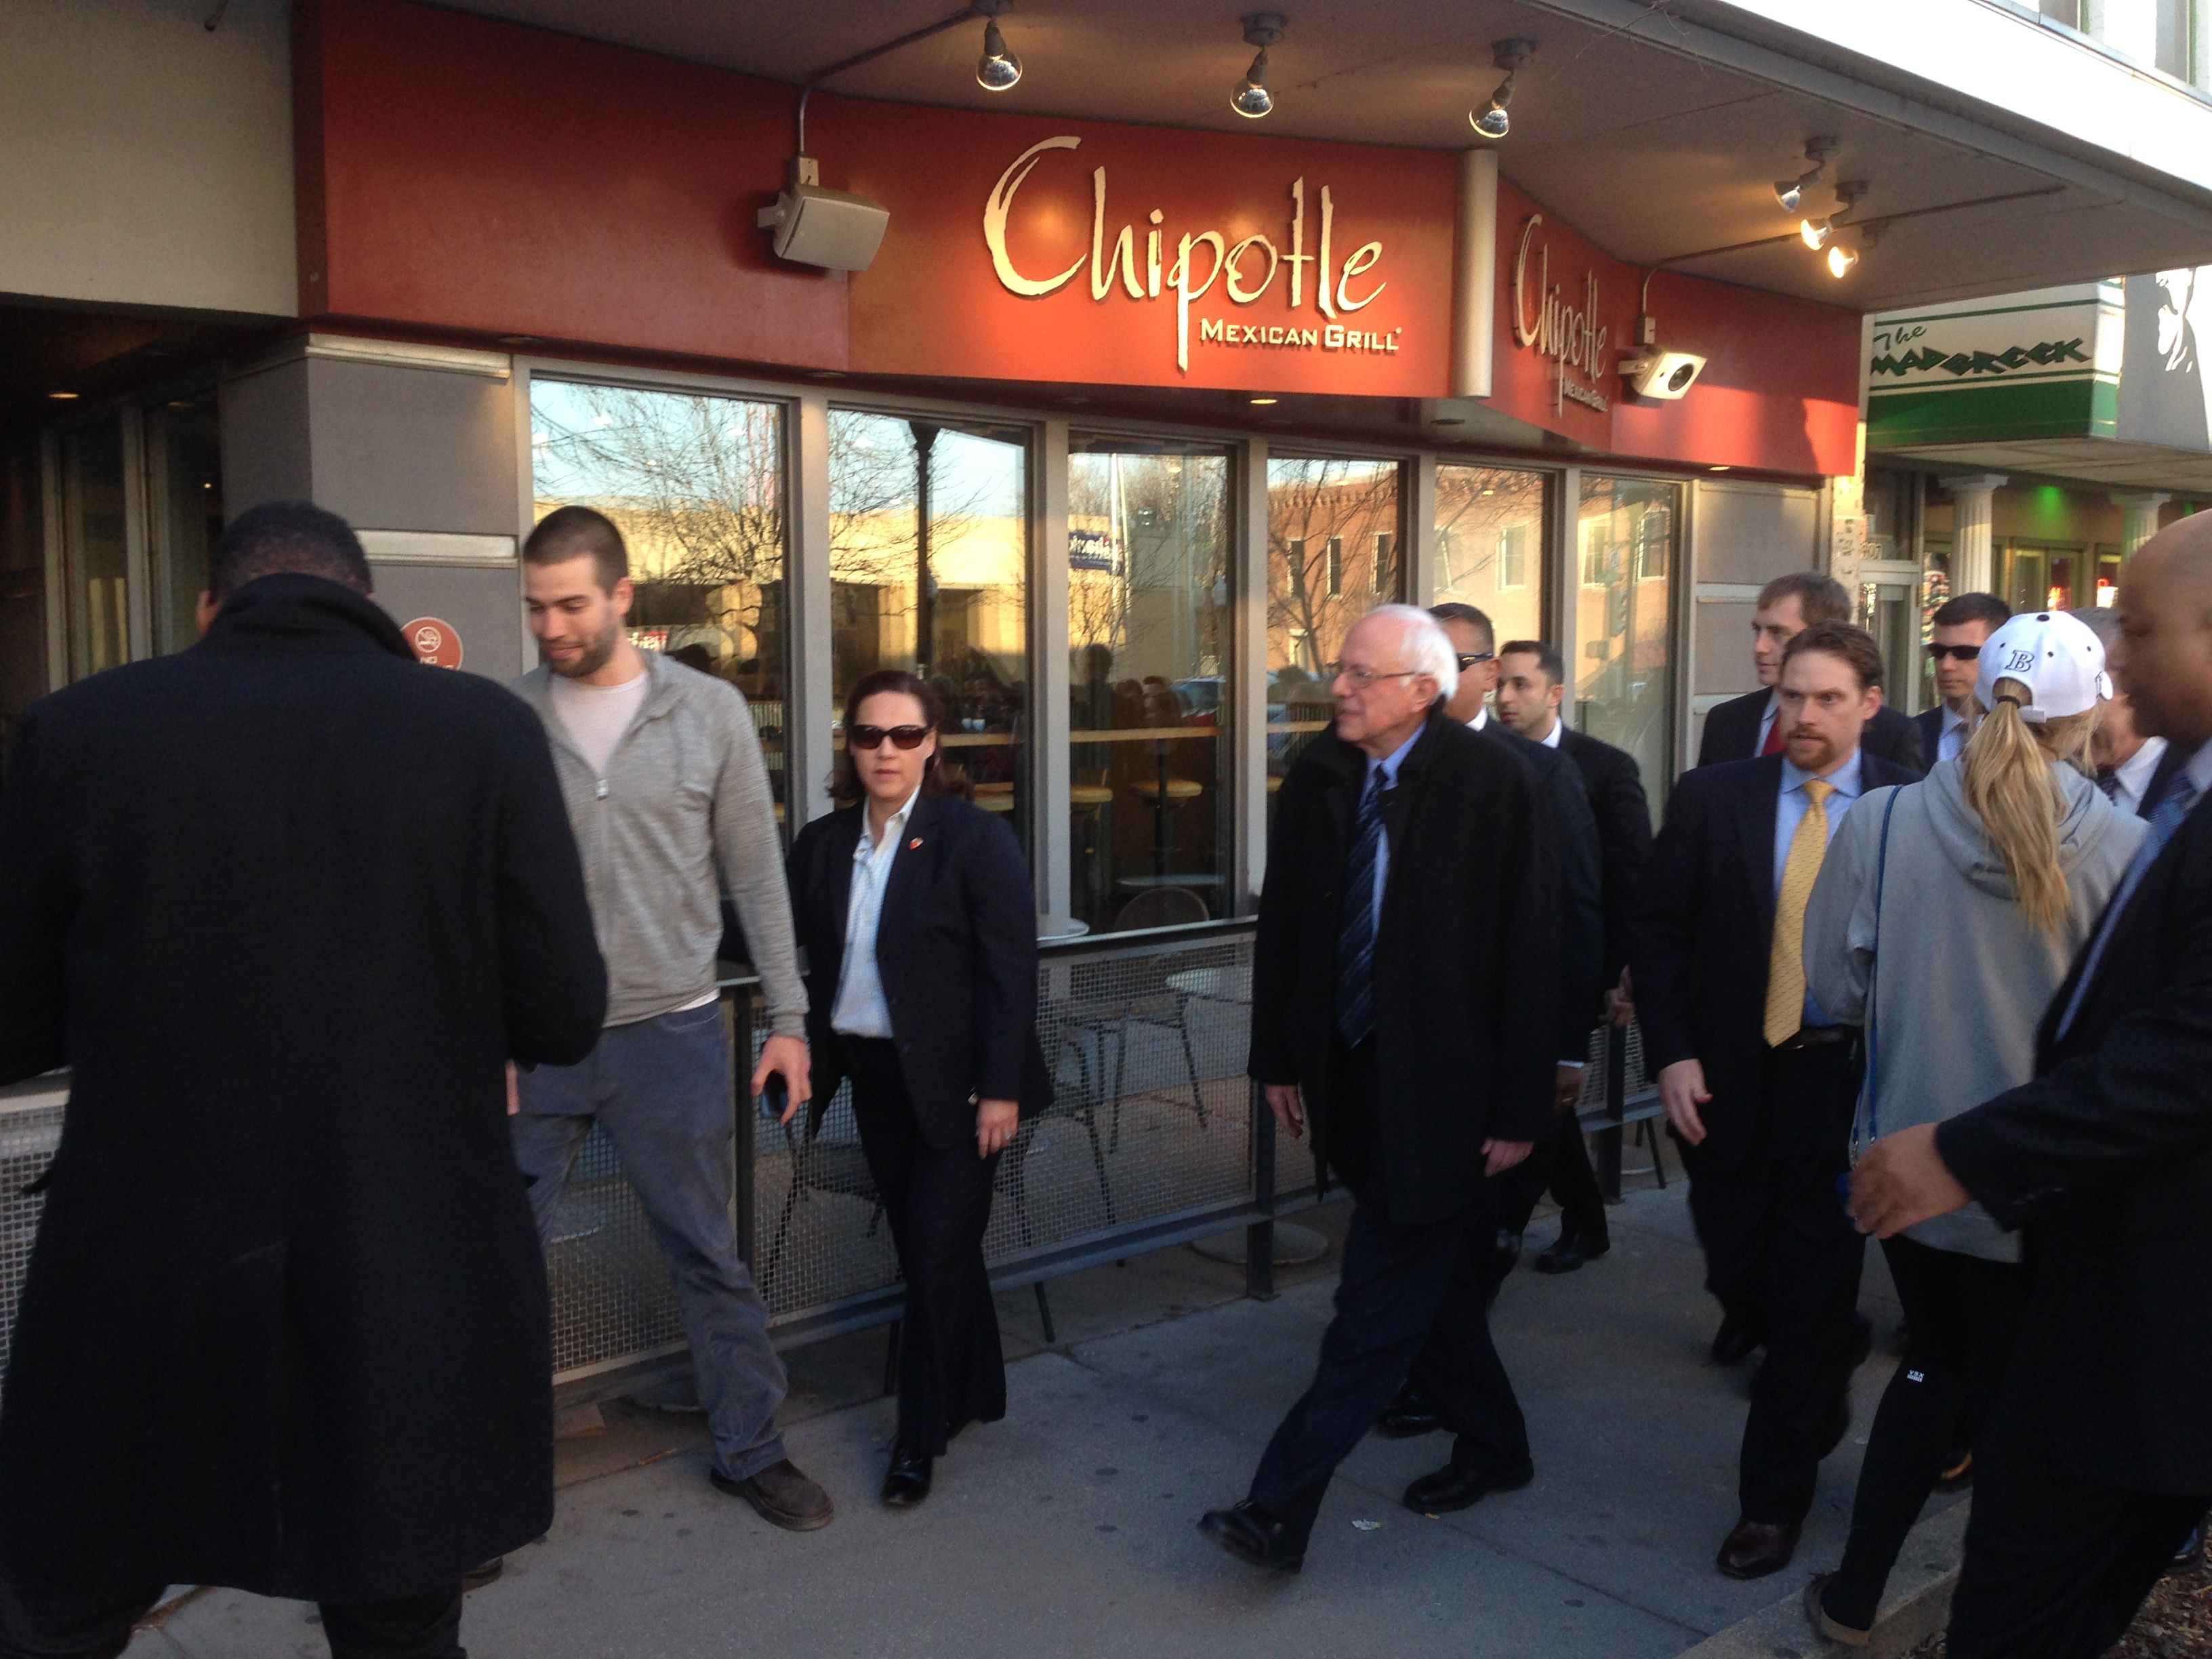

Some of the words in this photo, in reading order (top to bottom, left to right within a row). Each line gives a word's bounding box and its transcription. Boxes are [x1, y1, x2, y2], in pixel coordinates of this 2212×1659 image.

[983, 136, 1387, 373] Chipotle
[1517, 213, 1607, 418] Chipotle
[1201, 317, 1317, 346] MEXICAN
[1872, 325, 1927, 350] The
[2004, 649, 2035, 672] B
